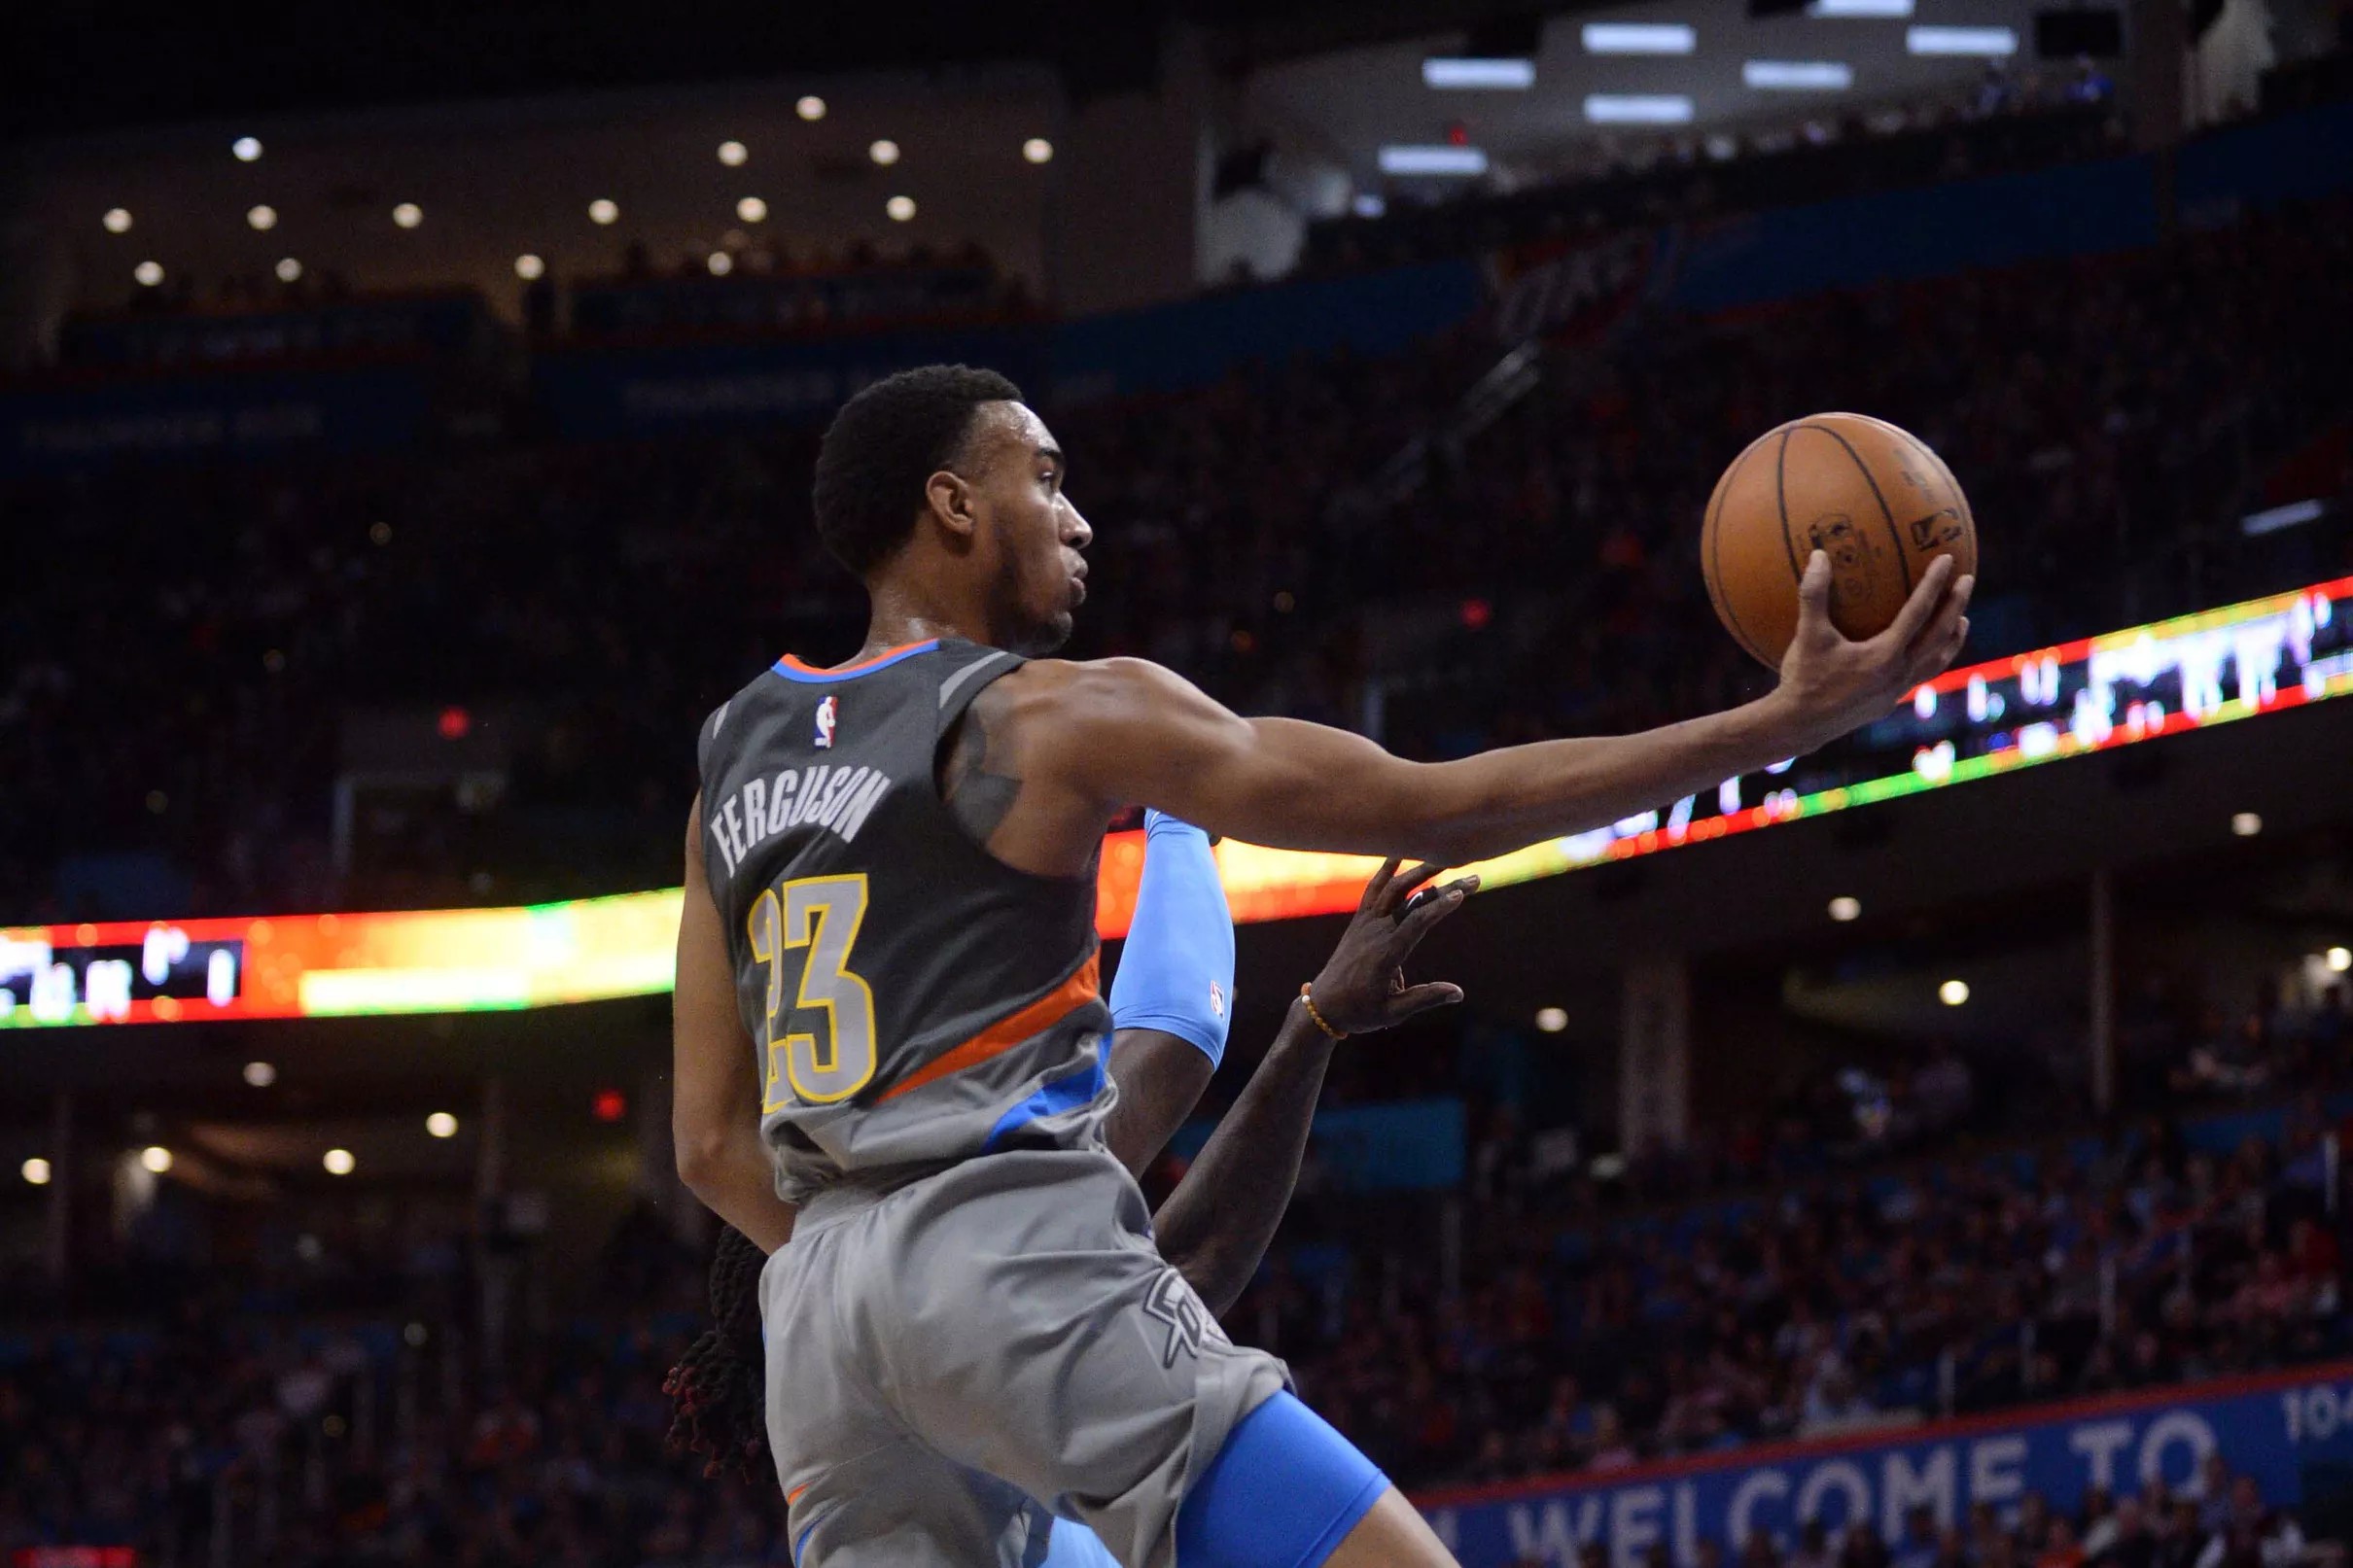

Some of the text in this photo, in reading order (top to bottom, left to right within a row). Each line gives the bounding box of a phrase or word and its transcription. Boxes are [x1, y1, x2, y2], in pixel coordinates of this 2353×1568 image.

[711, 764, 892, 879] FERGUSON
[747, 872, 877, 1114] 23
[1508, 1433, 2029, 1568] WELCOME
[2068, 1411, 2217, 1503] TO
